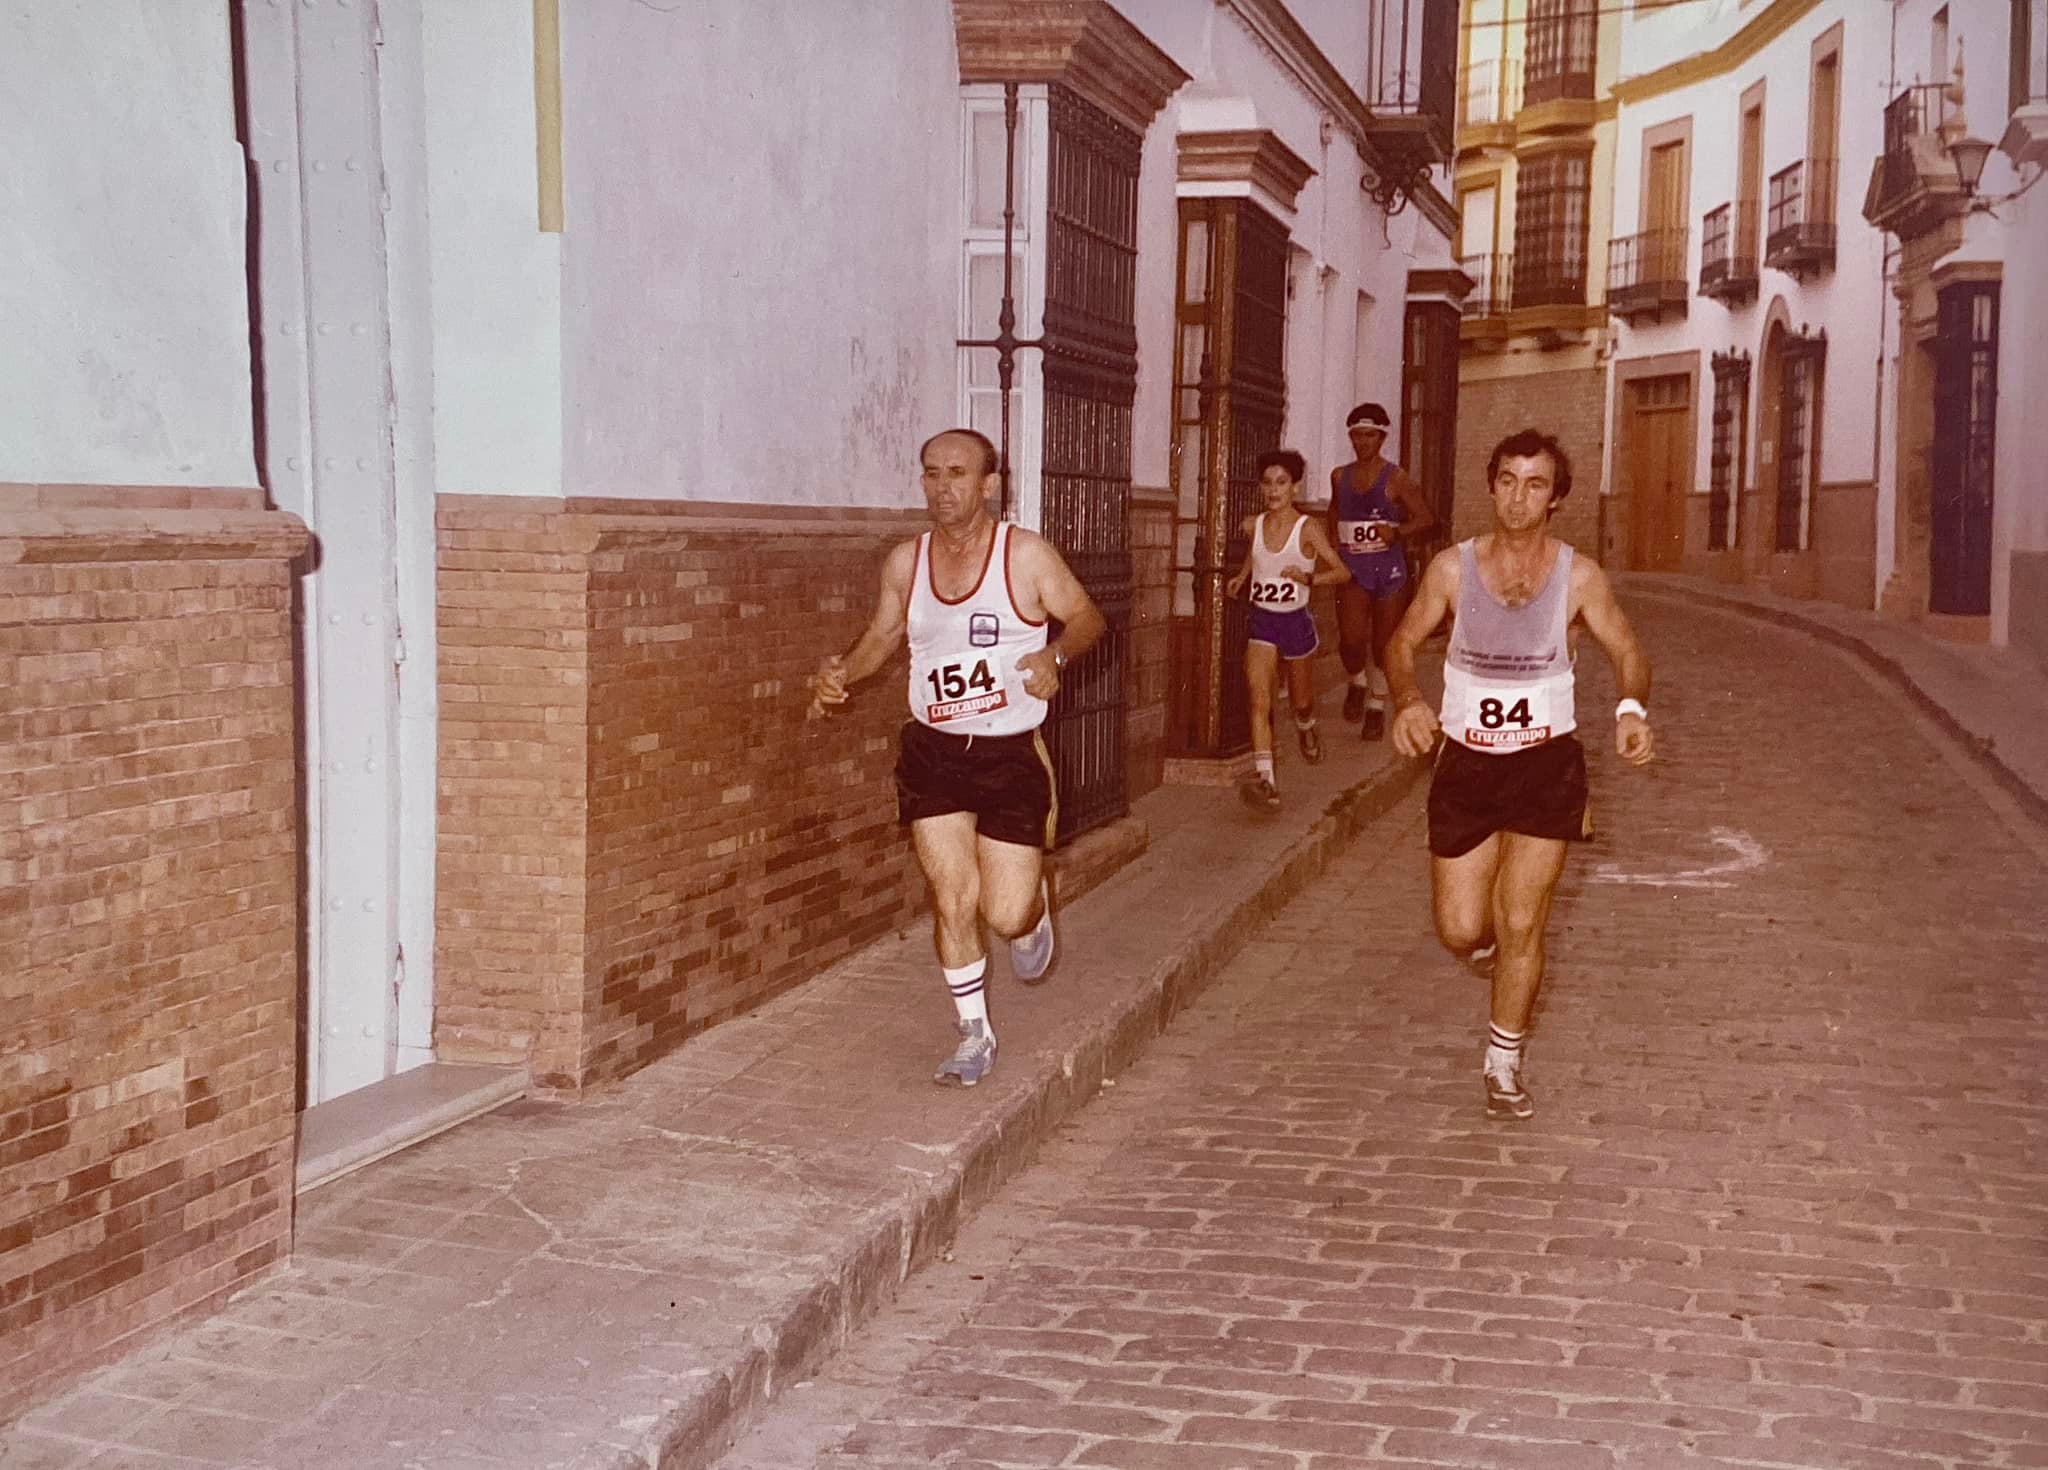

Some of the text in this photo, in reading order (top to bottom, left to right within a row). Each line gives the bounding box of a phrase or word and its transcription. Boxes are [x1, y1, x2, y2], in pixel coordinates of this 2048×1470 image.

[1353, 526, 1378, 542] 80
[1252, 582, 1296, 602] 222
[927, 659, 996, 702] 154
[1479, 697, 1533, 729] 84
